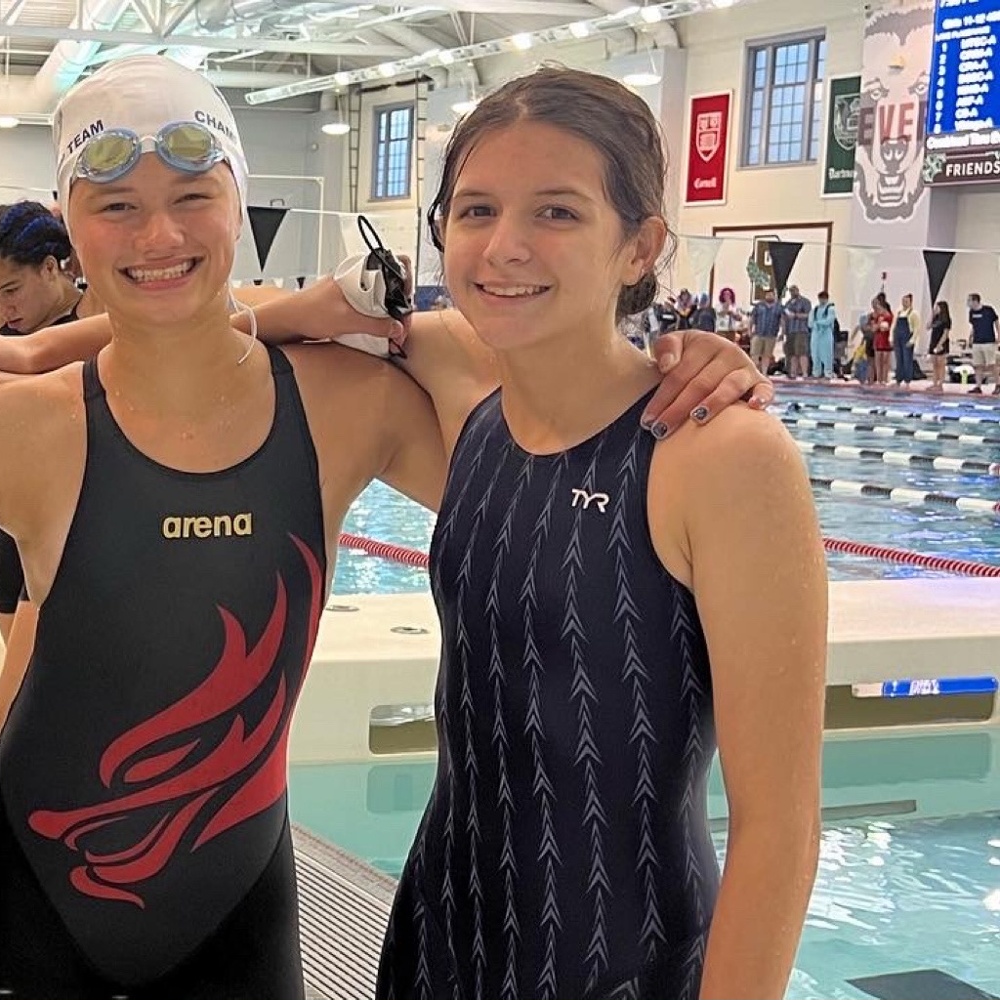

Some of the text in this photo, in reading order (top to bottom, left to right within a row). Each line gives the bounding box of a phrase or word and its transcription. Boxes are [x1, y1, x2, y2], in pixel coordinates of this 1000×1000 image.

[66, 119, 104, 154] TEAM
[857, 102, 929, 146] EVE
[946, 160, 1000, 177] FRIENDS
[571, 487, 610, 513] TYR
[162, 512, 253, 539] arena
